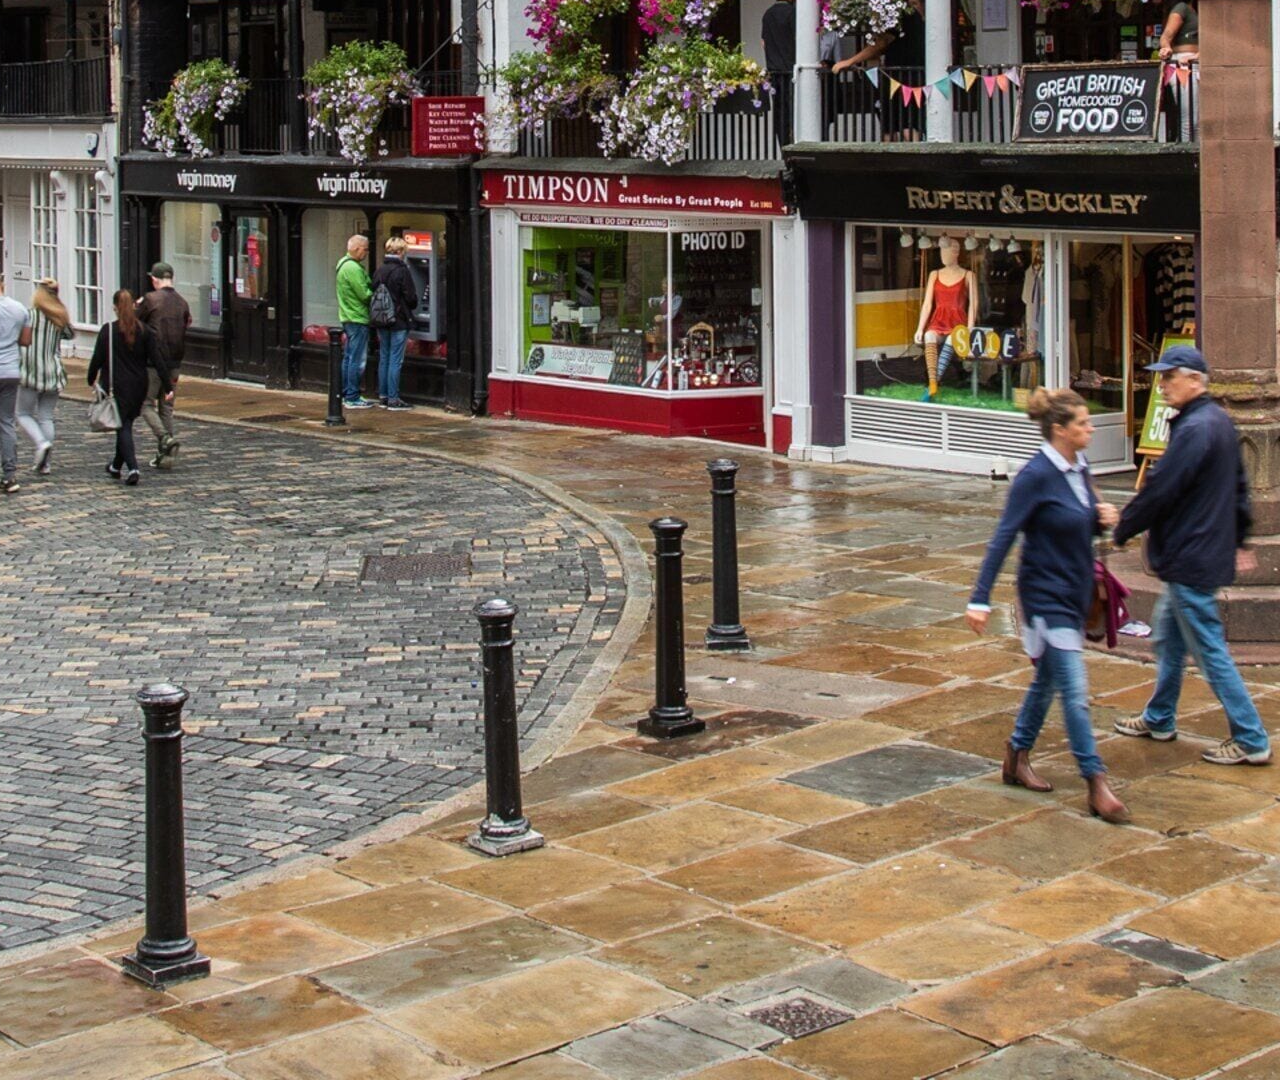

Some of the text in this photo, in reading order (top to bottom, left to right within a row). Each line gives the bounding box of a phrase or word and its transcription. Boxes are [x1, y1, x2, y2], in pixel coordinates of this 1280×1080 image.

[1036, 74, 1146, 100] GREAT BRITISH
[1058, 95, 1123, 108] HOMECOOKED
[1056, 108, 1119, 133] FOOD
[177, 169, 237, 193] virgin money
[317, 173, 388, 199] virgin money
[503, 175, 609, 203] TIMPSON
[618, 194, 641, 204] Great
[642, 195, 673, 206] Service
[675, 196, 687, 207] By
[688, 197, 712, 207] Great
[714, 198, 744, 209] People
[999, 184, 1025, 214] &
[593, 216, 668, 228] WE DO DRY CLEANING
[681, 231, 745, 251] PHOTO ID
[956, 329, 1015, 358] SALE
[1149, 406, 1171, 442] 50
